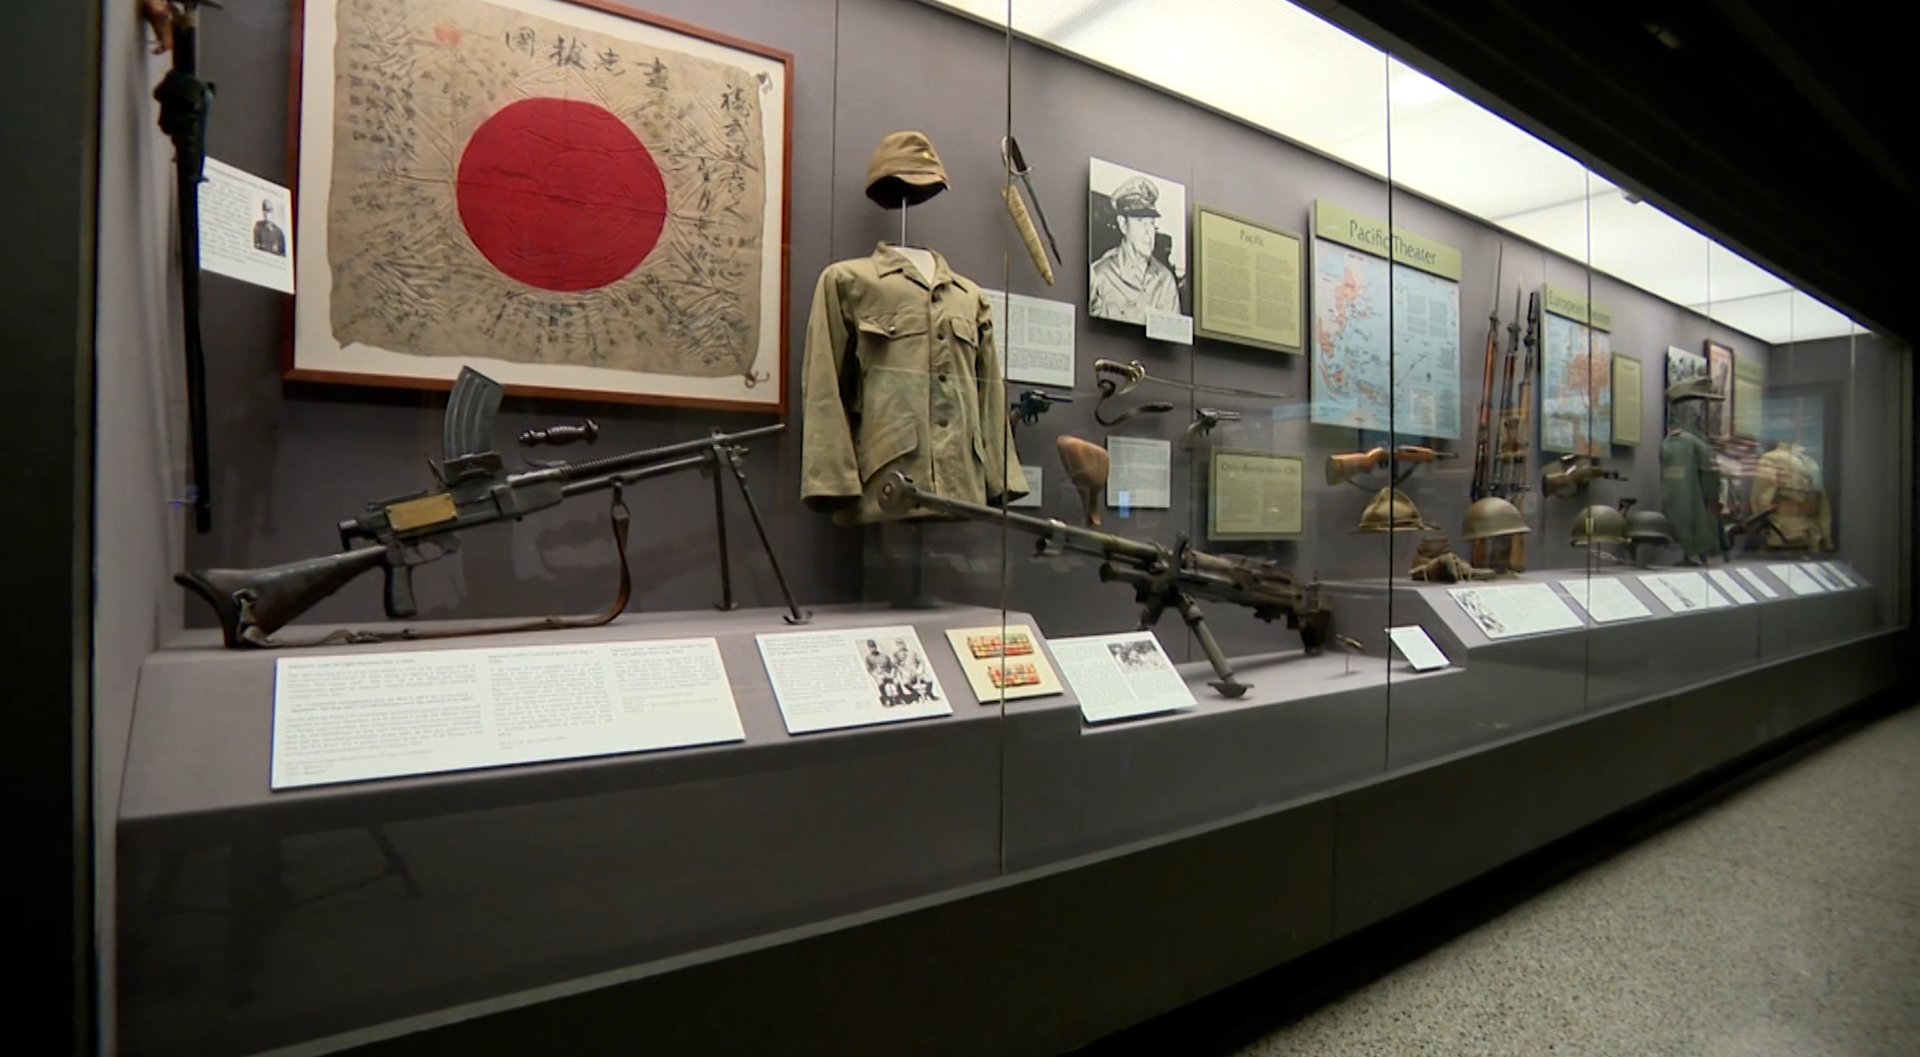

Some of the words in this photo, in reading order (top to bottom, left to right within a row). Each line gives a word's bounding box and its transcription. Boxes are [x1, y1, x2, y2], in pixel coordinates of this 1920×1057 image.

[1240, 229, 1265, 248] Pacific
[1349, 218, 1391, 250] Pacific
[1391, 235, 1437, 265] Theater
